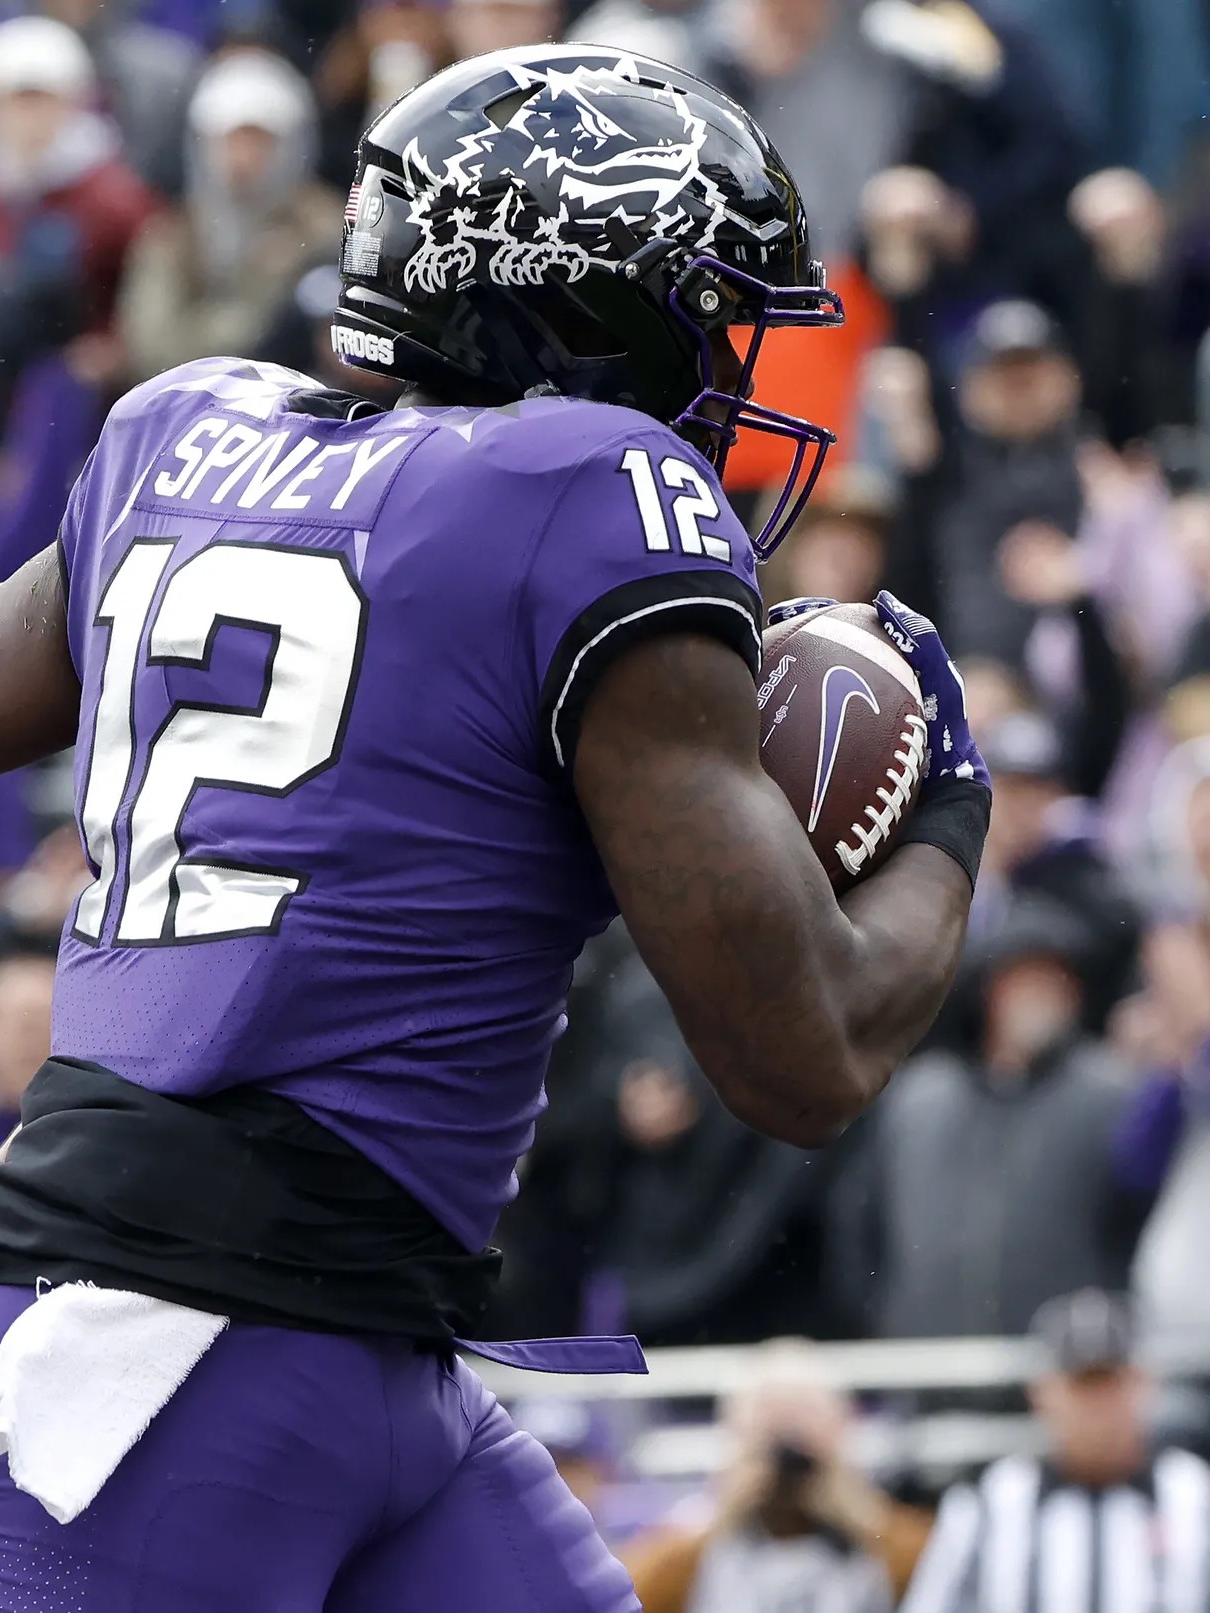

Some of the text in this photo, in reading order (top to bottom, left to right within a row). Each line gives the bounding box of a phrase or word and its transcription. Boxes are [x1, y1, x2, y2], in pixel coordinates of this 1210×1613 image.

[363, 196, 380, 221] 12
[336, 325, 395, 366] FROGS
[154, 417, 409, 510] SPIVEY
[615, 448, 732, 566] 12
[69, 536, 370, 948] 12
